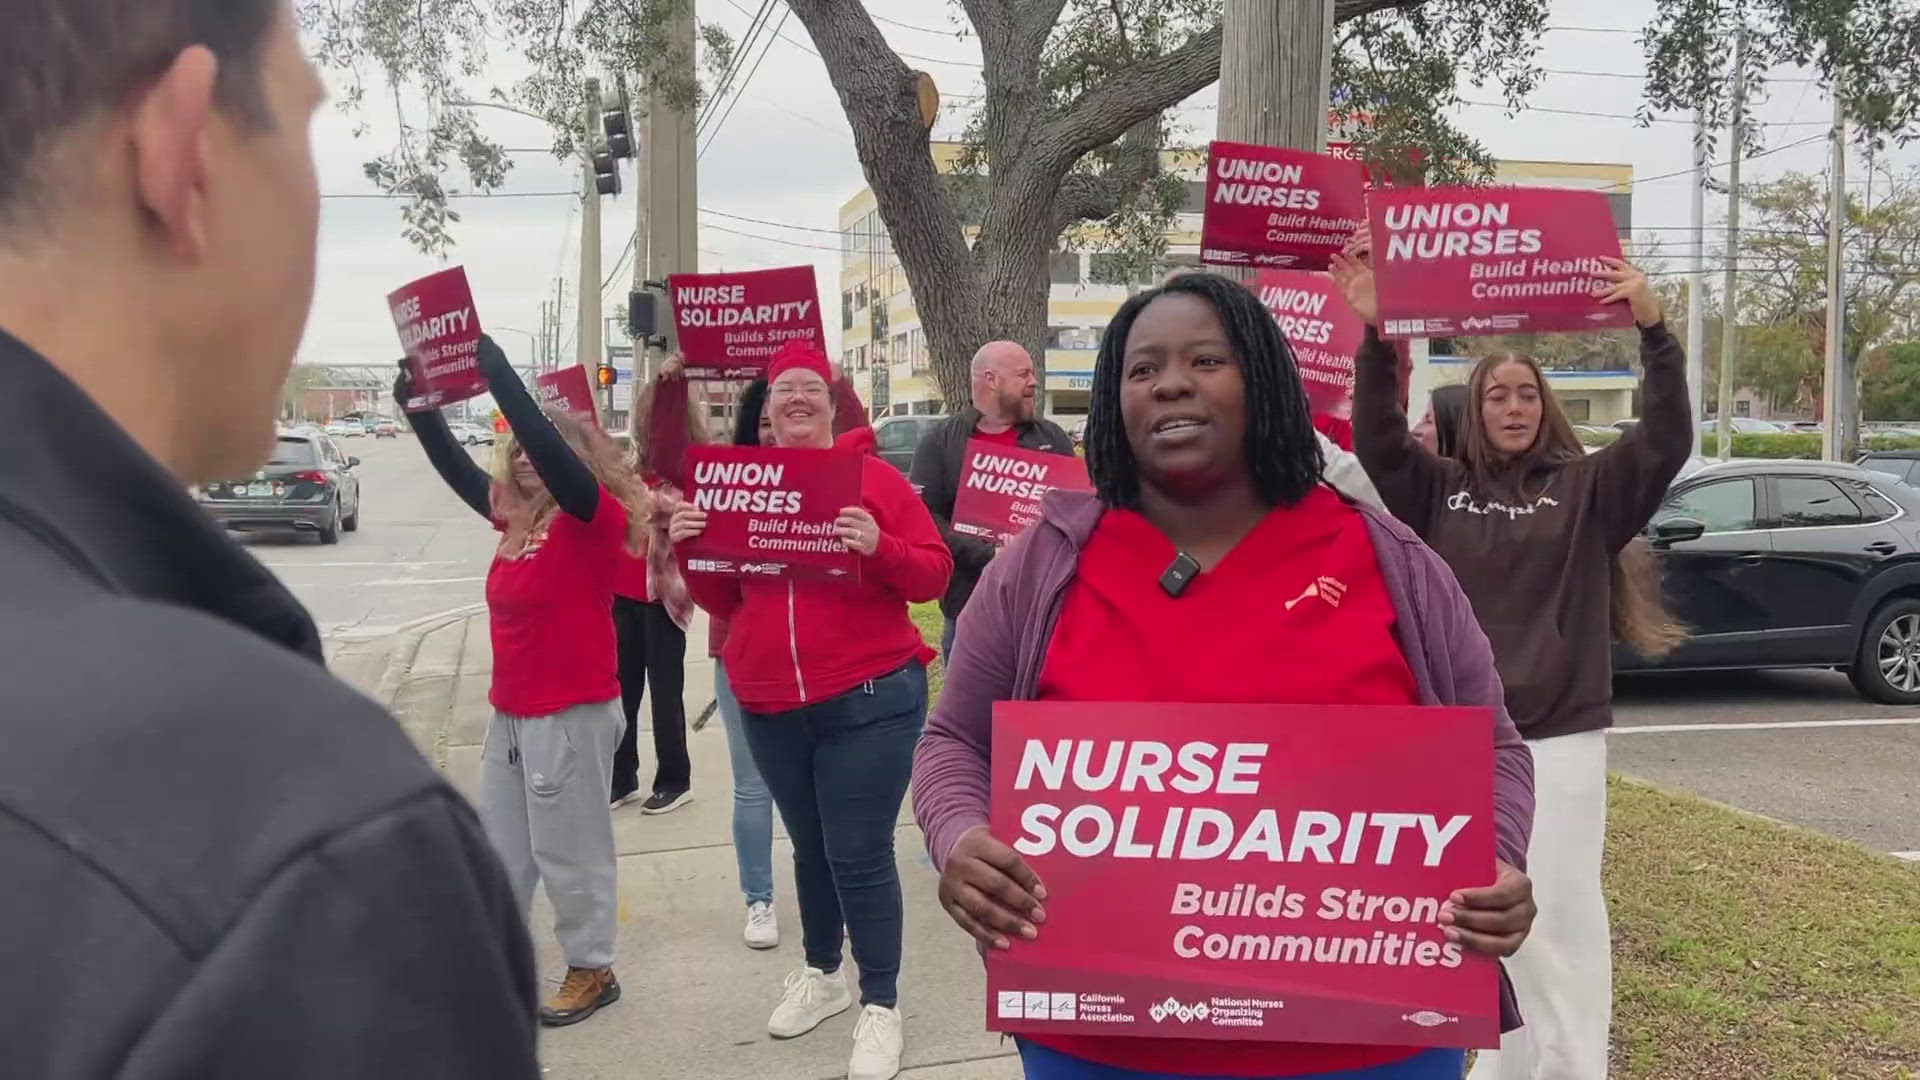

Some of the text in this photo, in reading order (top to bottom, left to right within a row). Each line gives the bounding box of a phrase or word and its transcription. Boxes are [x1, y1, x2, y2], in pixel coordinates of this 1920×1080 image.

[1216, 157, 1303, 185] UNION
[1213, 182, 1321, 210] NURSES
[1267, 213, 1306, 229] Build
[1384, 202, 1510, 231] UNION
[1385, 228, 1542, 261] NURSES
[1470, 259, 1526, 279] Build
[677, 284, 746, 305] NURSE
[1259, 284, 1328, 316] UNION
[680, 299, 812, 328] SOLIDARITY
[724, 326, 816, 344] Builds Strong
[693, 461, 785, 487] UNION
[972, 452, 1048, 482] UNION
[966, 471, 1057, 501] NURSE
[694, 488, 803, 514] NURSES
[748, 518, 788, 534] Build
[1013, 738, 1269, 795] NURSE
[1012, 803, 1473, 867] SOLIDARITY
[1170, 882, 1305, 919] Builds
[1172, 926, 1463, 968] Communities
[1079, 992, 1126, 1005] California
[1079, 1003, 1112, 1013] Nurses
[1211, 996, 1284, 1009] National Nurses
[1079, 1013, 1135, 1023] Association
[1210, 1006, 1263, 1018] Organizing
[1210, 1016, 1264, 1027] Committee
